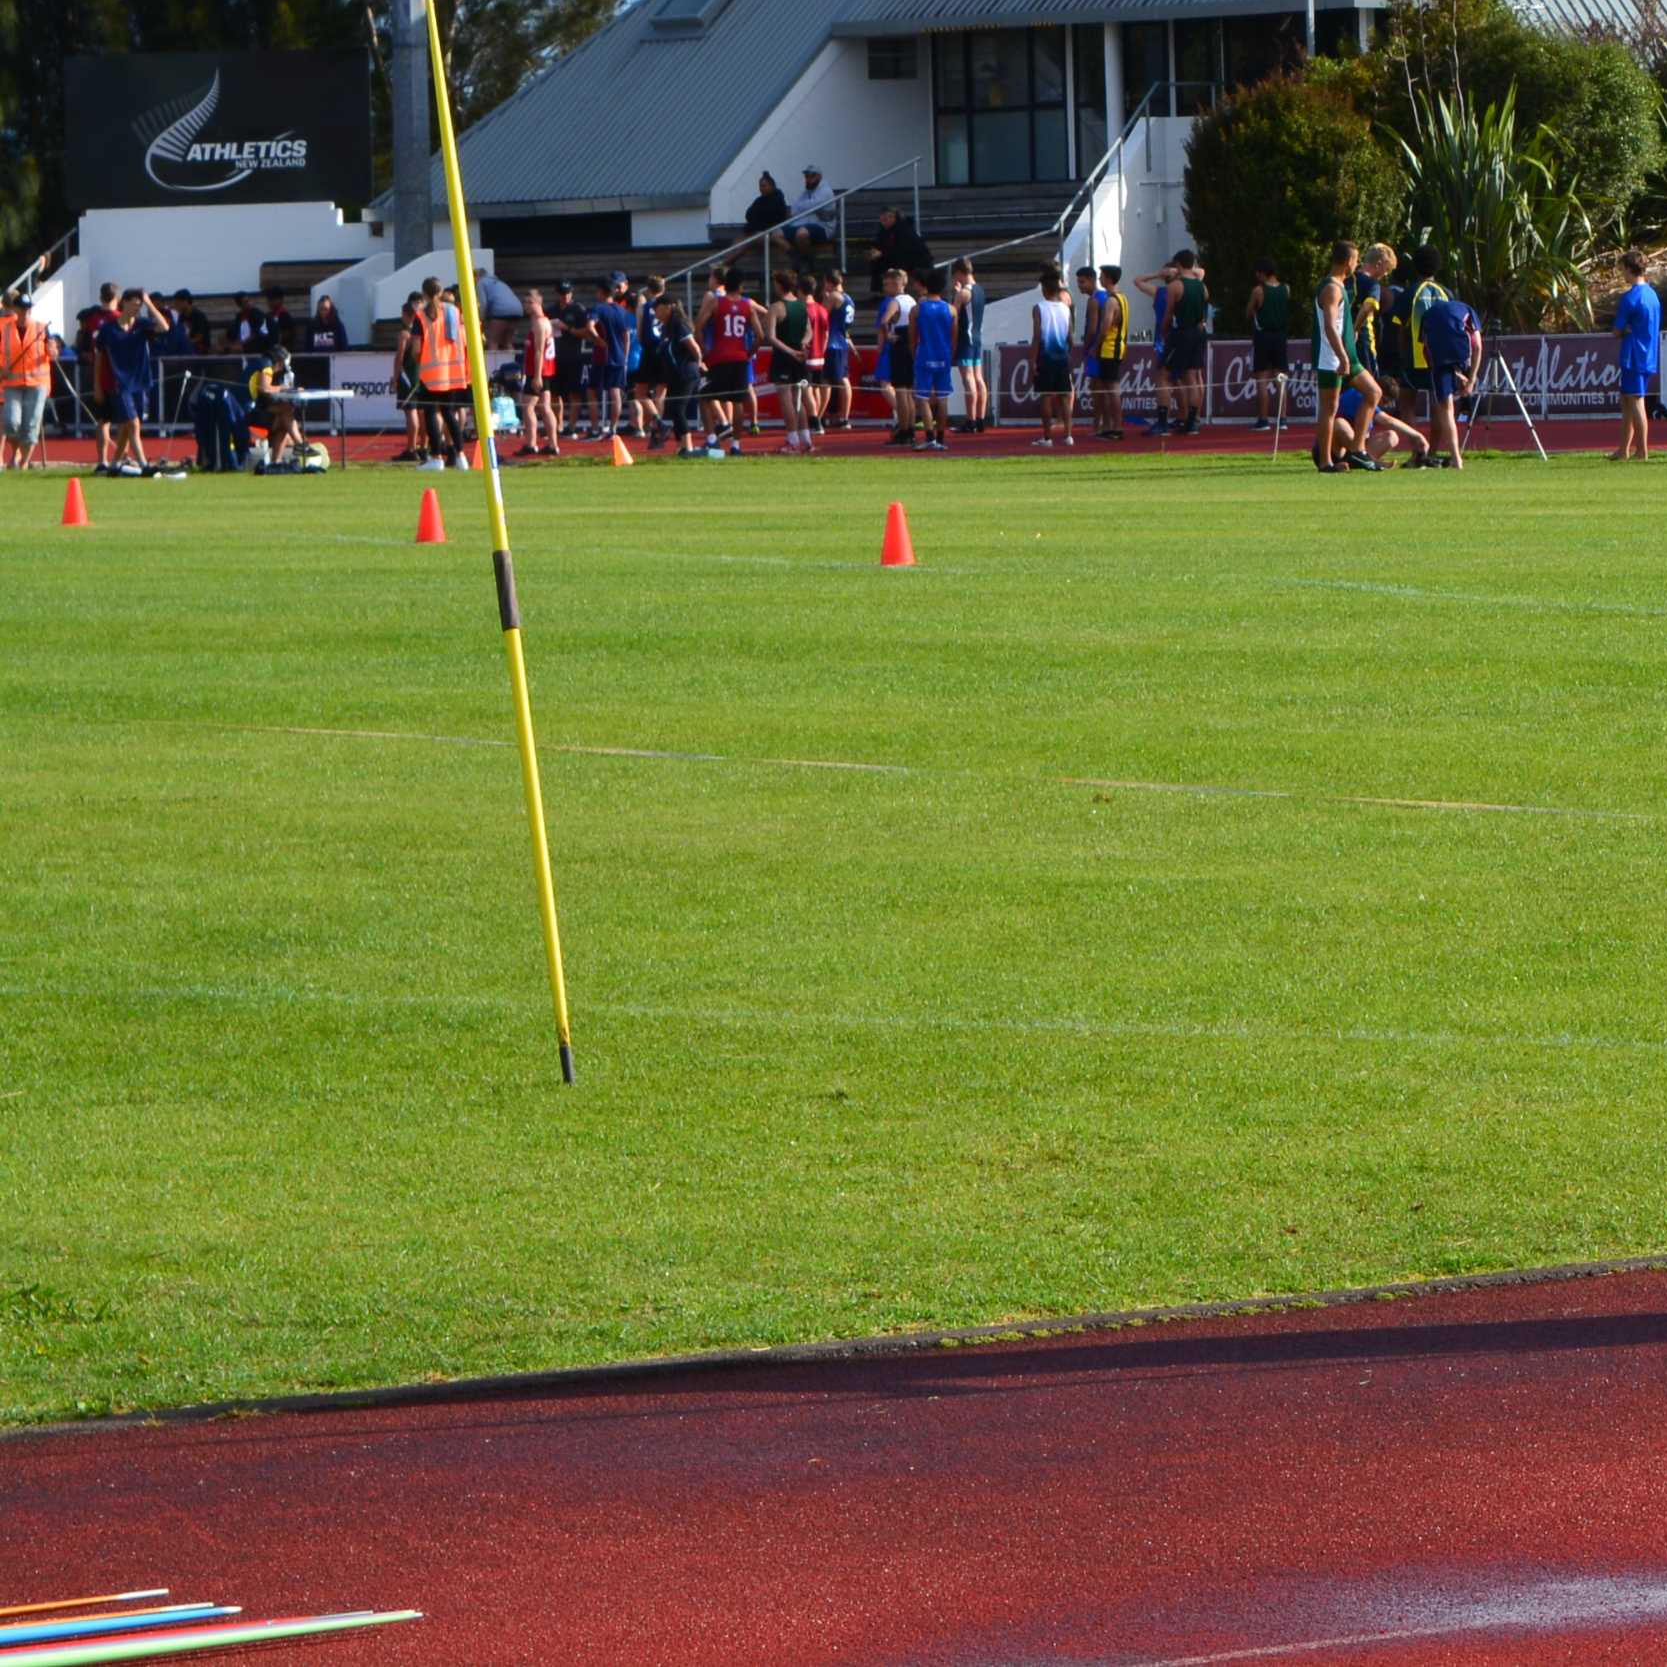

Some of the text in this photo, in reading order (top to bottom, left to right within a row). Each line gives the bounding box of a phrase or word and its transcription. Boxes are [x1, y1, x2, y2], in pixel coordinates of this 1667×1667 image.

[187, 140, 307, 161] ATHLETICS
[235, 157, 306, 168] NEW ZEALAND
[723, 314, 746, 337] 16
